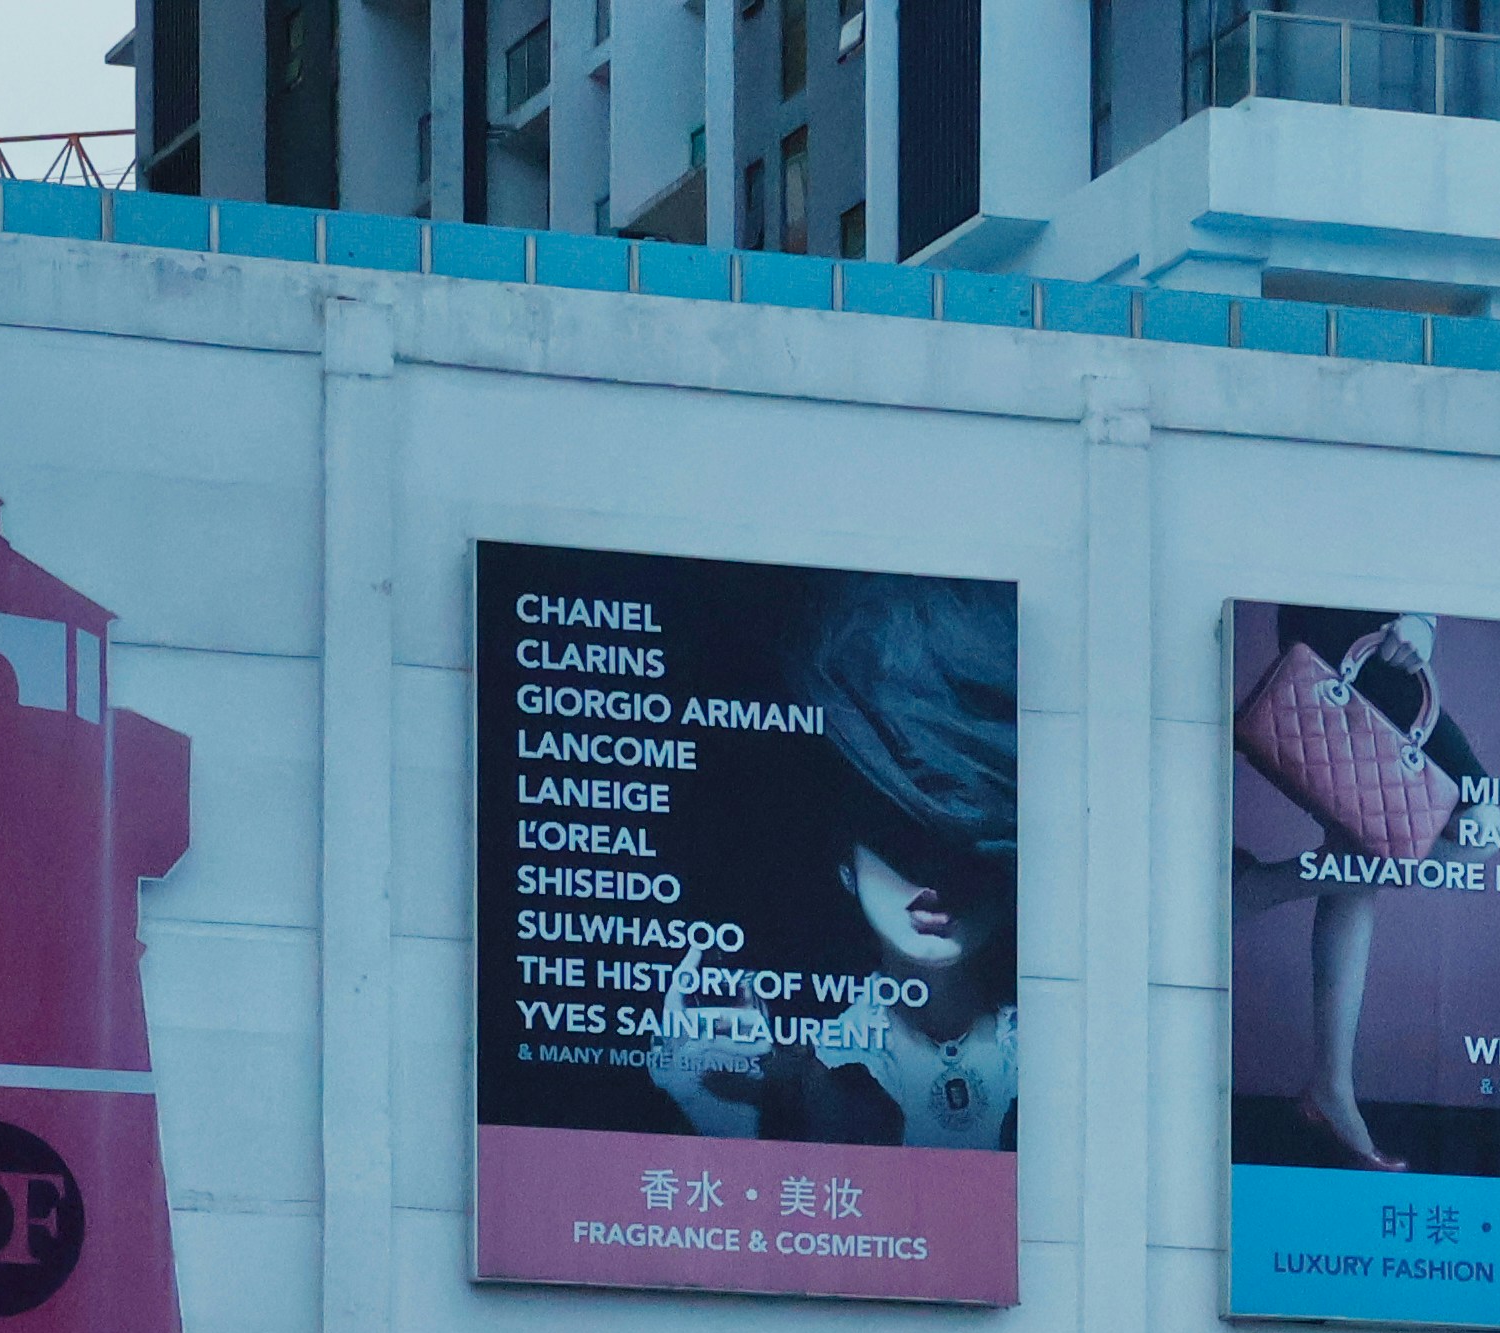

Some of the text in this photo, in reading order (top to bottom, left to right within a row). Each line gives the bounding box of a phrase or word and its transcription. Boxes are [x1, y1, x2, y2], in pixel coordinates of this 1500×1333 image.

[516, 594, 662, 633] CHANEL
[516, 640, 665, 678] CLARINS
[516, 685, 825, 735] GIORGIO ARMANI
[517, 731, 698, 770] LANCOME
[517, 776, 670, 814] LANEIGE
[516, 866, 681, 904] SHISEIDO
[1299, 853, 1485, 891] SALVATORE
[516, 911, 744, 952] SULWHASOO
[516, 956, 929, 1008] THE HISTORY OF WHOO
[517, 1002, 890, 1050] YVES SAINT LAURENT
[517, 1043, 762, 1075] & MANY MORE BRANDS
[1480, 1077, 1494, 1096] &
[573, 1221, 929, 1261] FRAGRANCE & COSMETICS
[1273, 1251, 1374, 1278] LUXURY
[1381, 1256, 1494, 1284] FASHION
